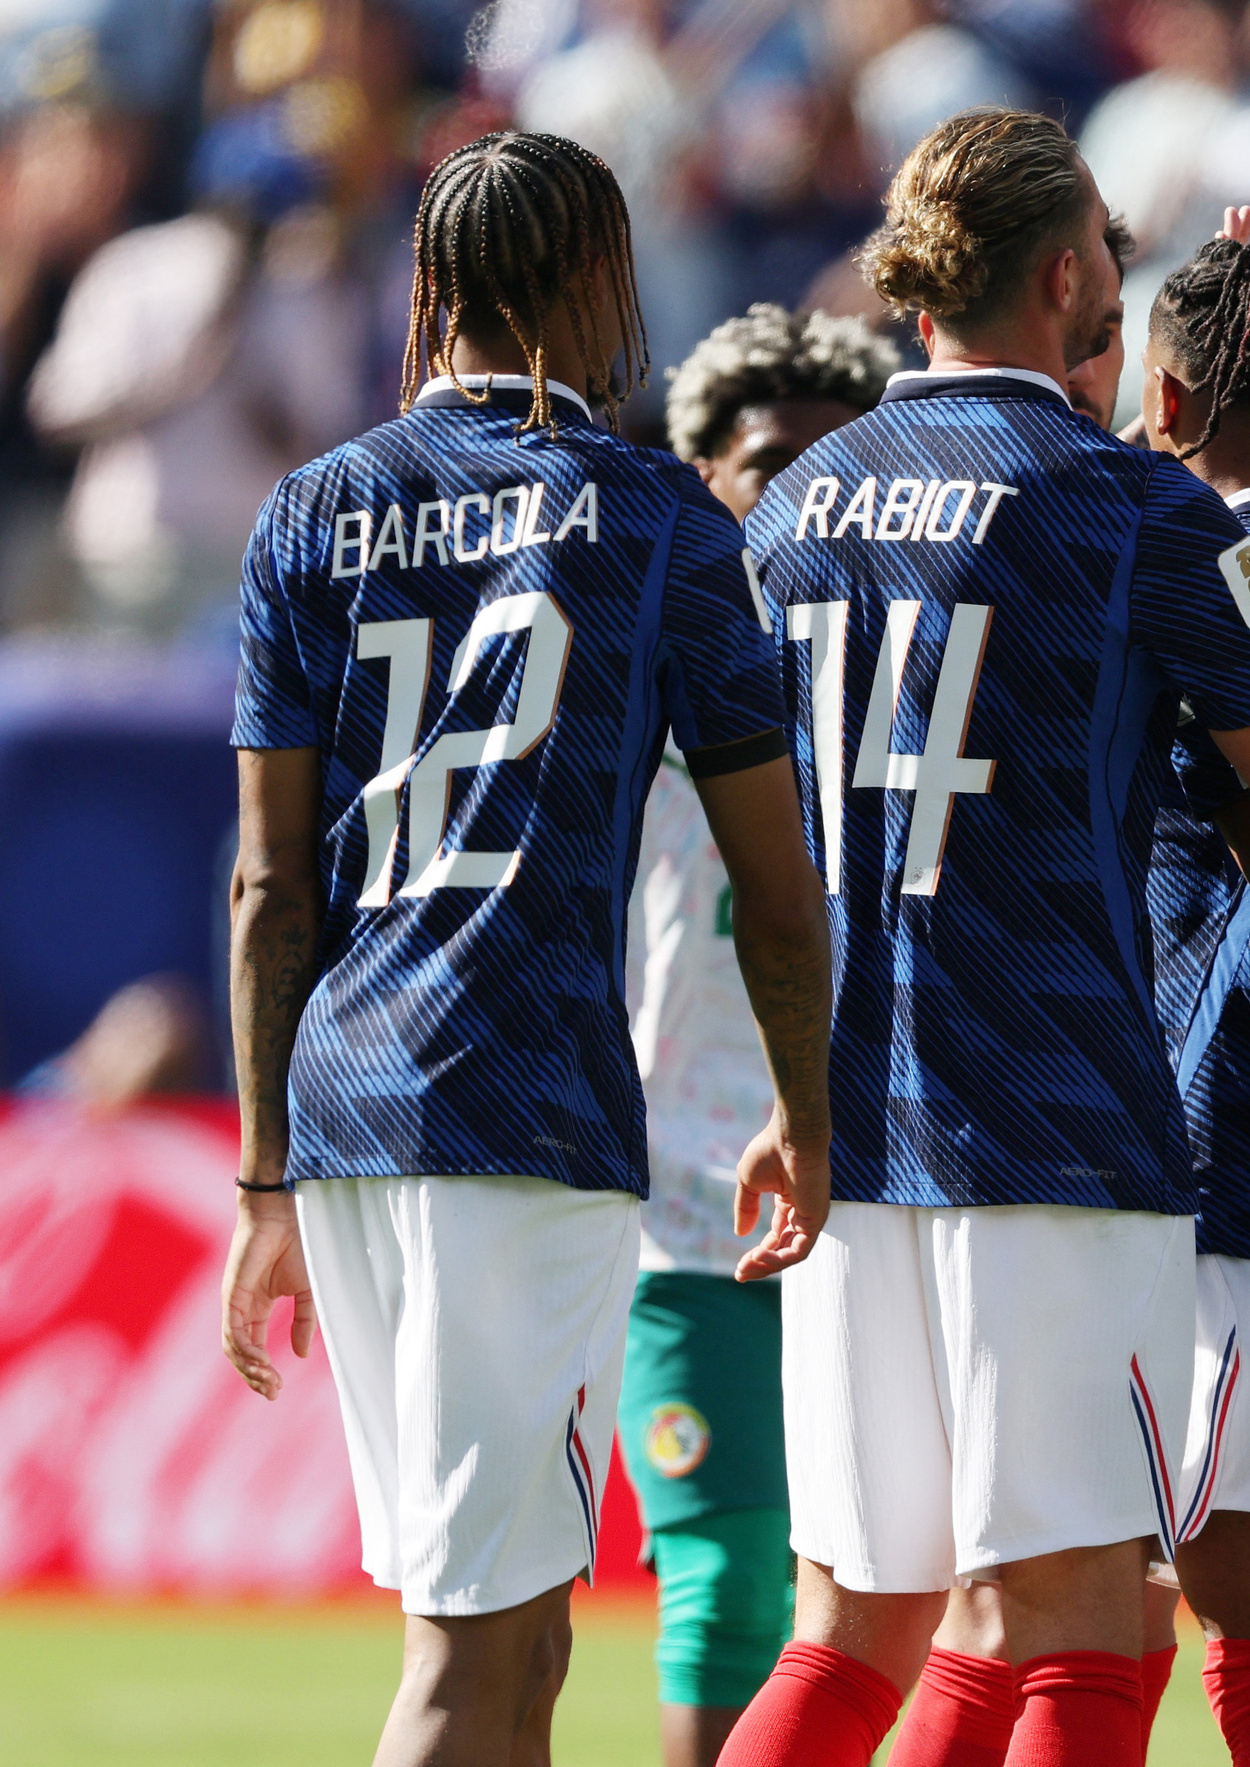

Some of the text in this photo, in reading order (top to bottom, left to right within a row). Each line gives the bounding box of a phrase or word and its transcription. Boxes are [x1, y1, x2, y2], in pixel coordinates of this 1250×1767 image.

[331, 482, 598, 579] BARCOLA
[795, 476, 1019, 544] RABIOT
[356, 591, 574, 908] 12
[786, 600, 998, 897] 14
[1060, 1167, 1118, 1179] AERO-FIT
